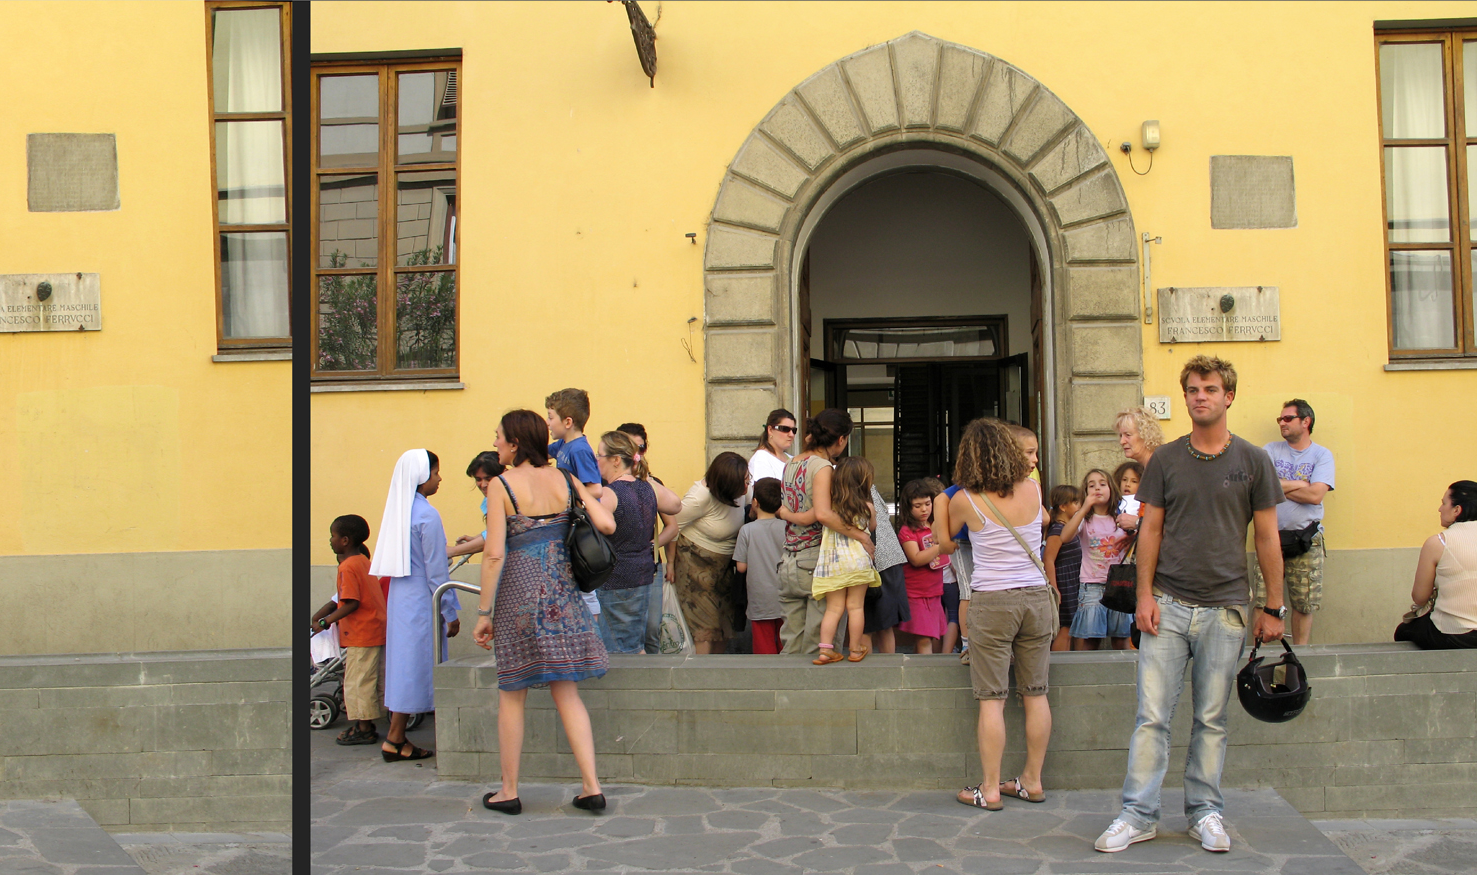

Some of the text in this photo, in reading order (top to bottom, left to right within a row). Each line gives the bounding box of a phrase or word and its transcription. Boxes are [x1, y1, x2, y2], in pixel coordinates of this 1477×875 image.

[7, 304, 56, 312] ELEMENTARE
[59, 303, 99, 311] MASCHILE
[45, 314, 94, 324] FERRVCCI
[1167, 325, 1273, 335] FRANCESCO FERRVCCI
[1149, 401, 1166, 415] 83
